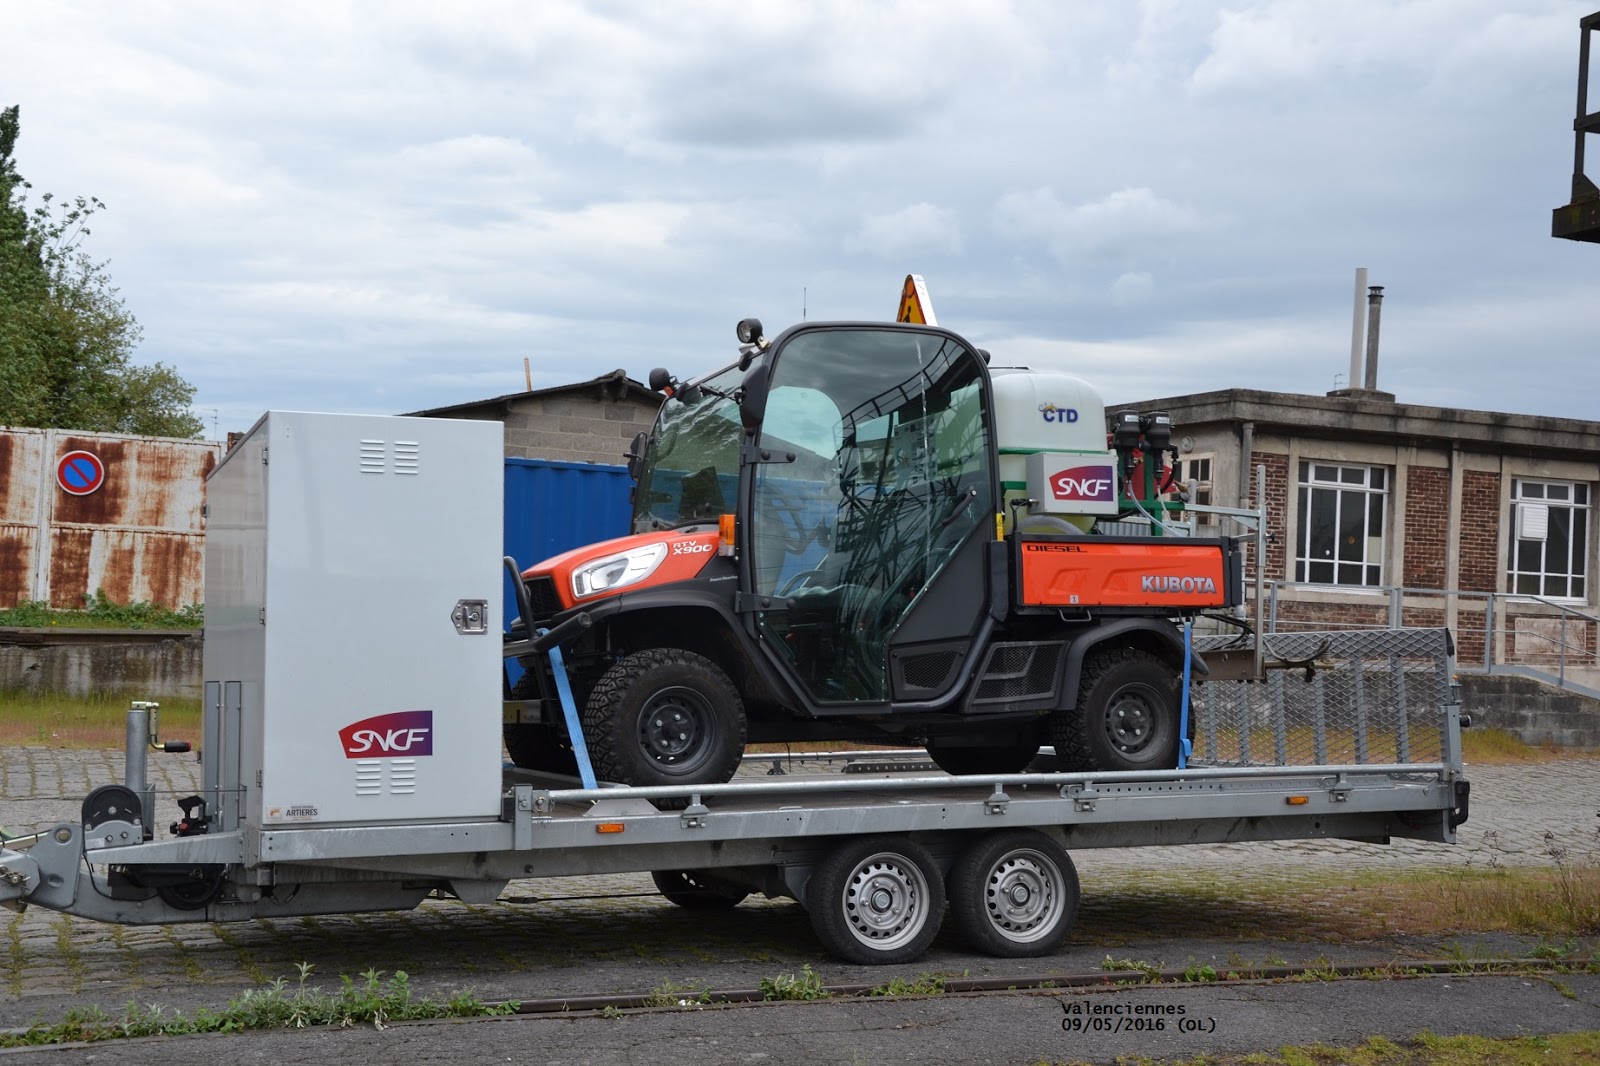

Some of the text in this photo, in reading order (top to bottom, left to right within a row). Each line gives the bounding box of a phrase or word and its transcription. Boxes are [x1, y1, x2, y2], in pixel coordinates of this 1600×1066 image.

[1042, 407, 1078, 423] CTD
[1056, 477, 1111, 496] SNCF
[673, 544, 713, 555] X900
[1026, 545, 1088, 553] DIESEL
[1141, 575, 1217, 594] KUBOTA
[349, 728, 429, 753] SNCF
[286, 808, 318, 817] ARTIERES
